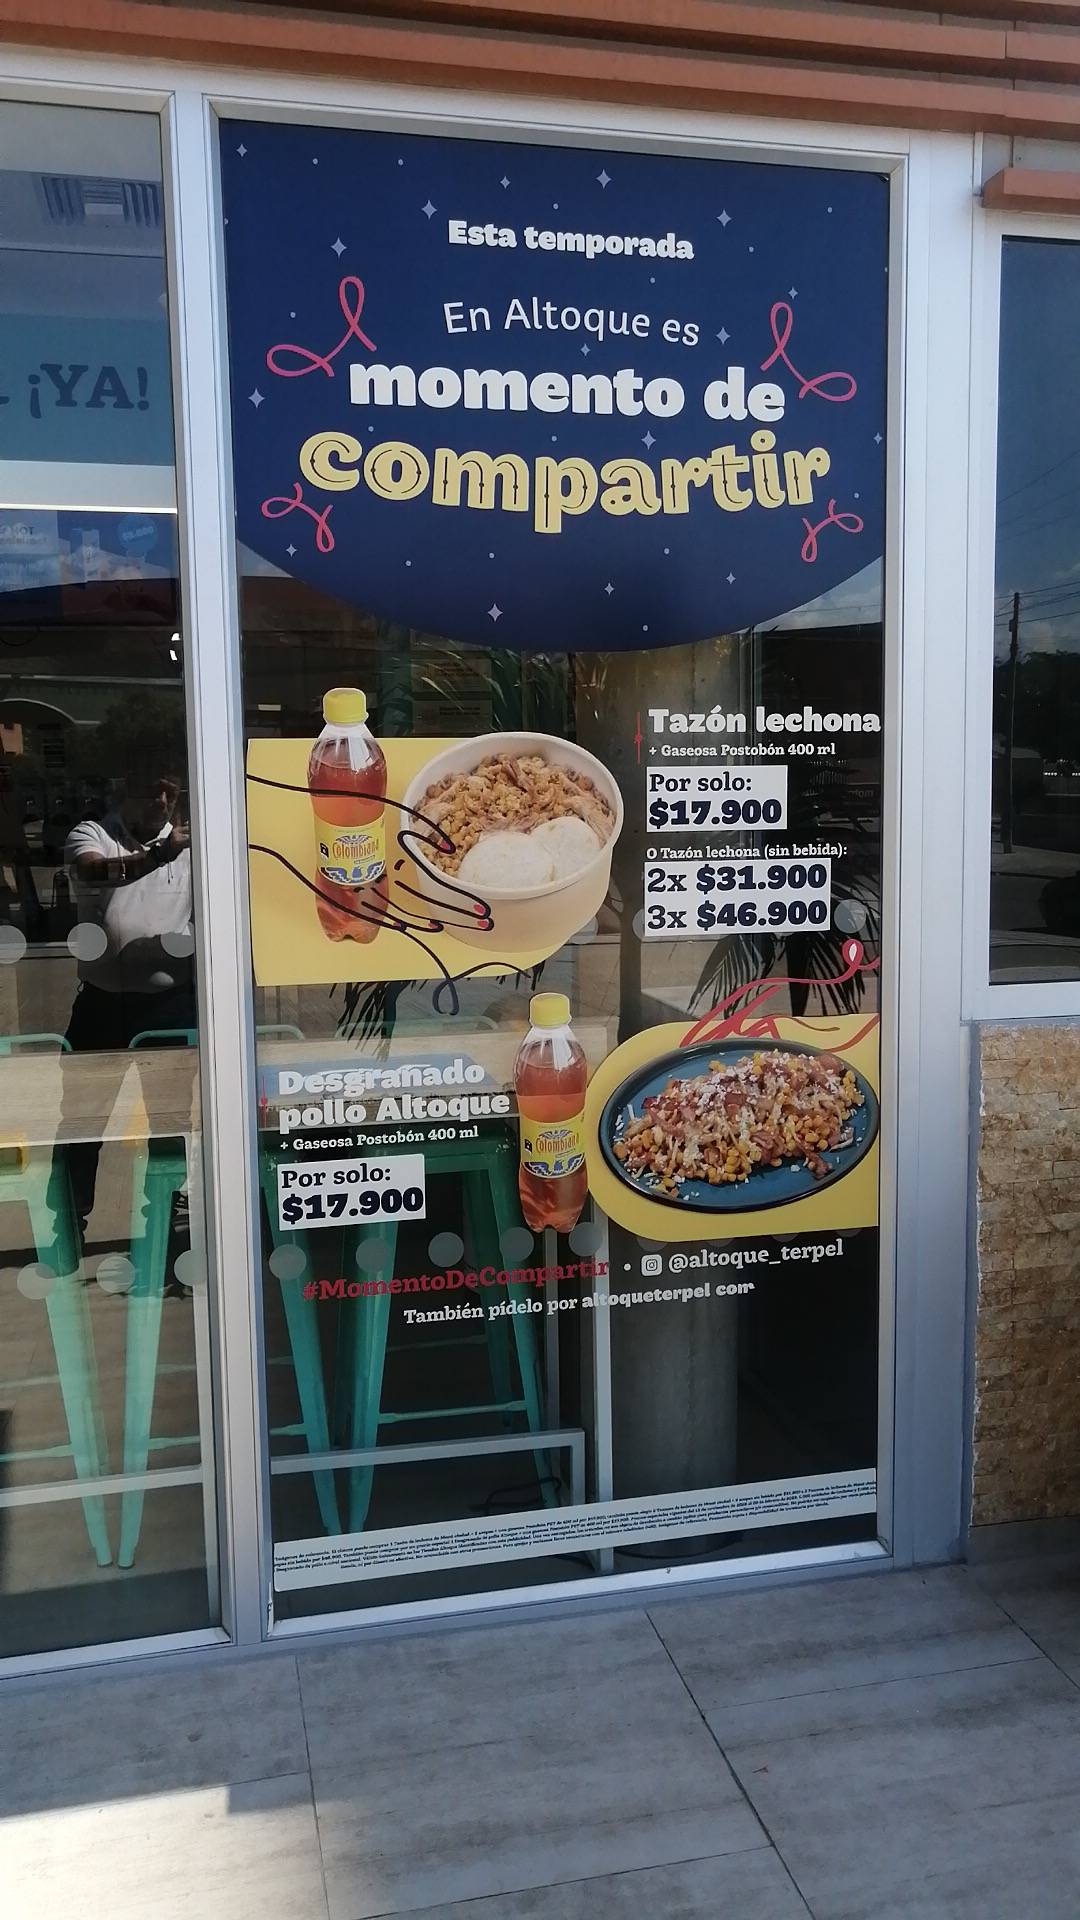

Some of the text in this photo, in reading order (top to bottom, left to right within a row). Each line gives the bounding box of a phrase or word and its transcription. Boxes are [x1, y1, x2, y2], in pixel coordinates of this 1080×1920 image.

[449, 219, 695, 261] Esta temporada
[443, 297, 700, 346] En Altoque es
[28, 363, 150, 419] ¡YA!
[349, 363, 785, 422] momento de
[299, 430, 831, 534] compartir
[648, 704, 881, 734] Tazón lechona
[661, 744, 718, 757] Gaseosa
[720, 743, 785, 756] Postobón
[787, 743, 815, 756] 400
[649, 771, 752, 792] Por solo:
[649, 797, 782, 829] $17.900
[660, 845, 703, 859] Tazón
[705, 845, 761, 859] lechona
[764, 843, 790, 860] (sin
[793, 842, 848, 859] bebida):
[647, 863, 828, 895] 2x $31.900
[647, 900, 828, 931] 3x $46.900
[278, 1058, 486, 1098] Desgranado
[279, 1094, 511, 1135] pollo Altoque
[292, 1137, 354, 1151] Gaseosa
[356, 1129, 425, 1146] Postobón
[428, 1127, 455, 1141] 400
[459, 1125, 479, 1139] ml
[281, 1163, 391, 1189] Por solo:
[281, 1186, 425, 1225] $17.900
[303, 1238, 844, 1301] #MomentoDeCompartir @altoque_terpel
[403, 1301, 484, 1325] También
[488, 1297, 543, 1322] pídelo
[547, 1296, 579, 1316] por
